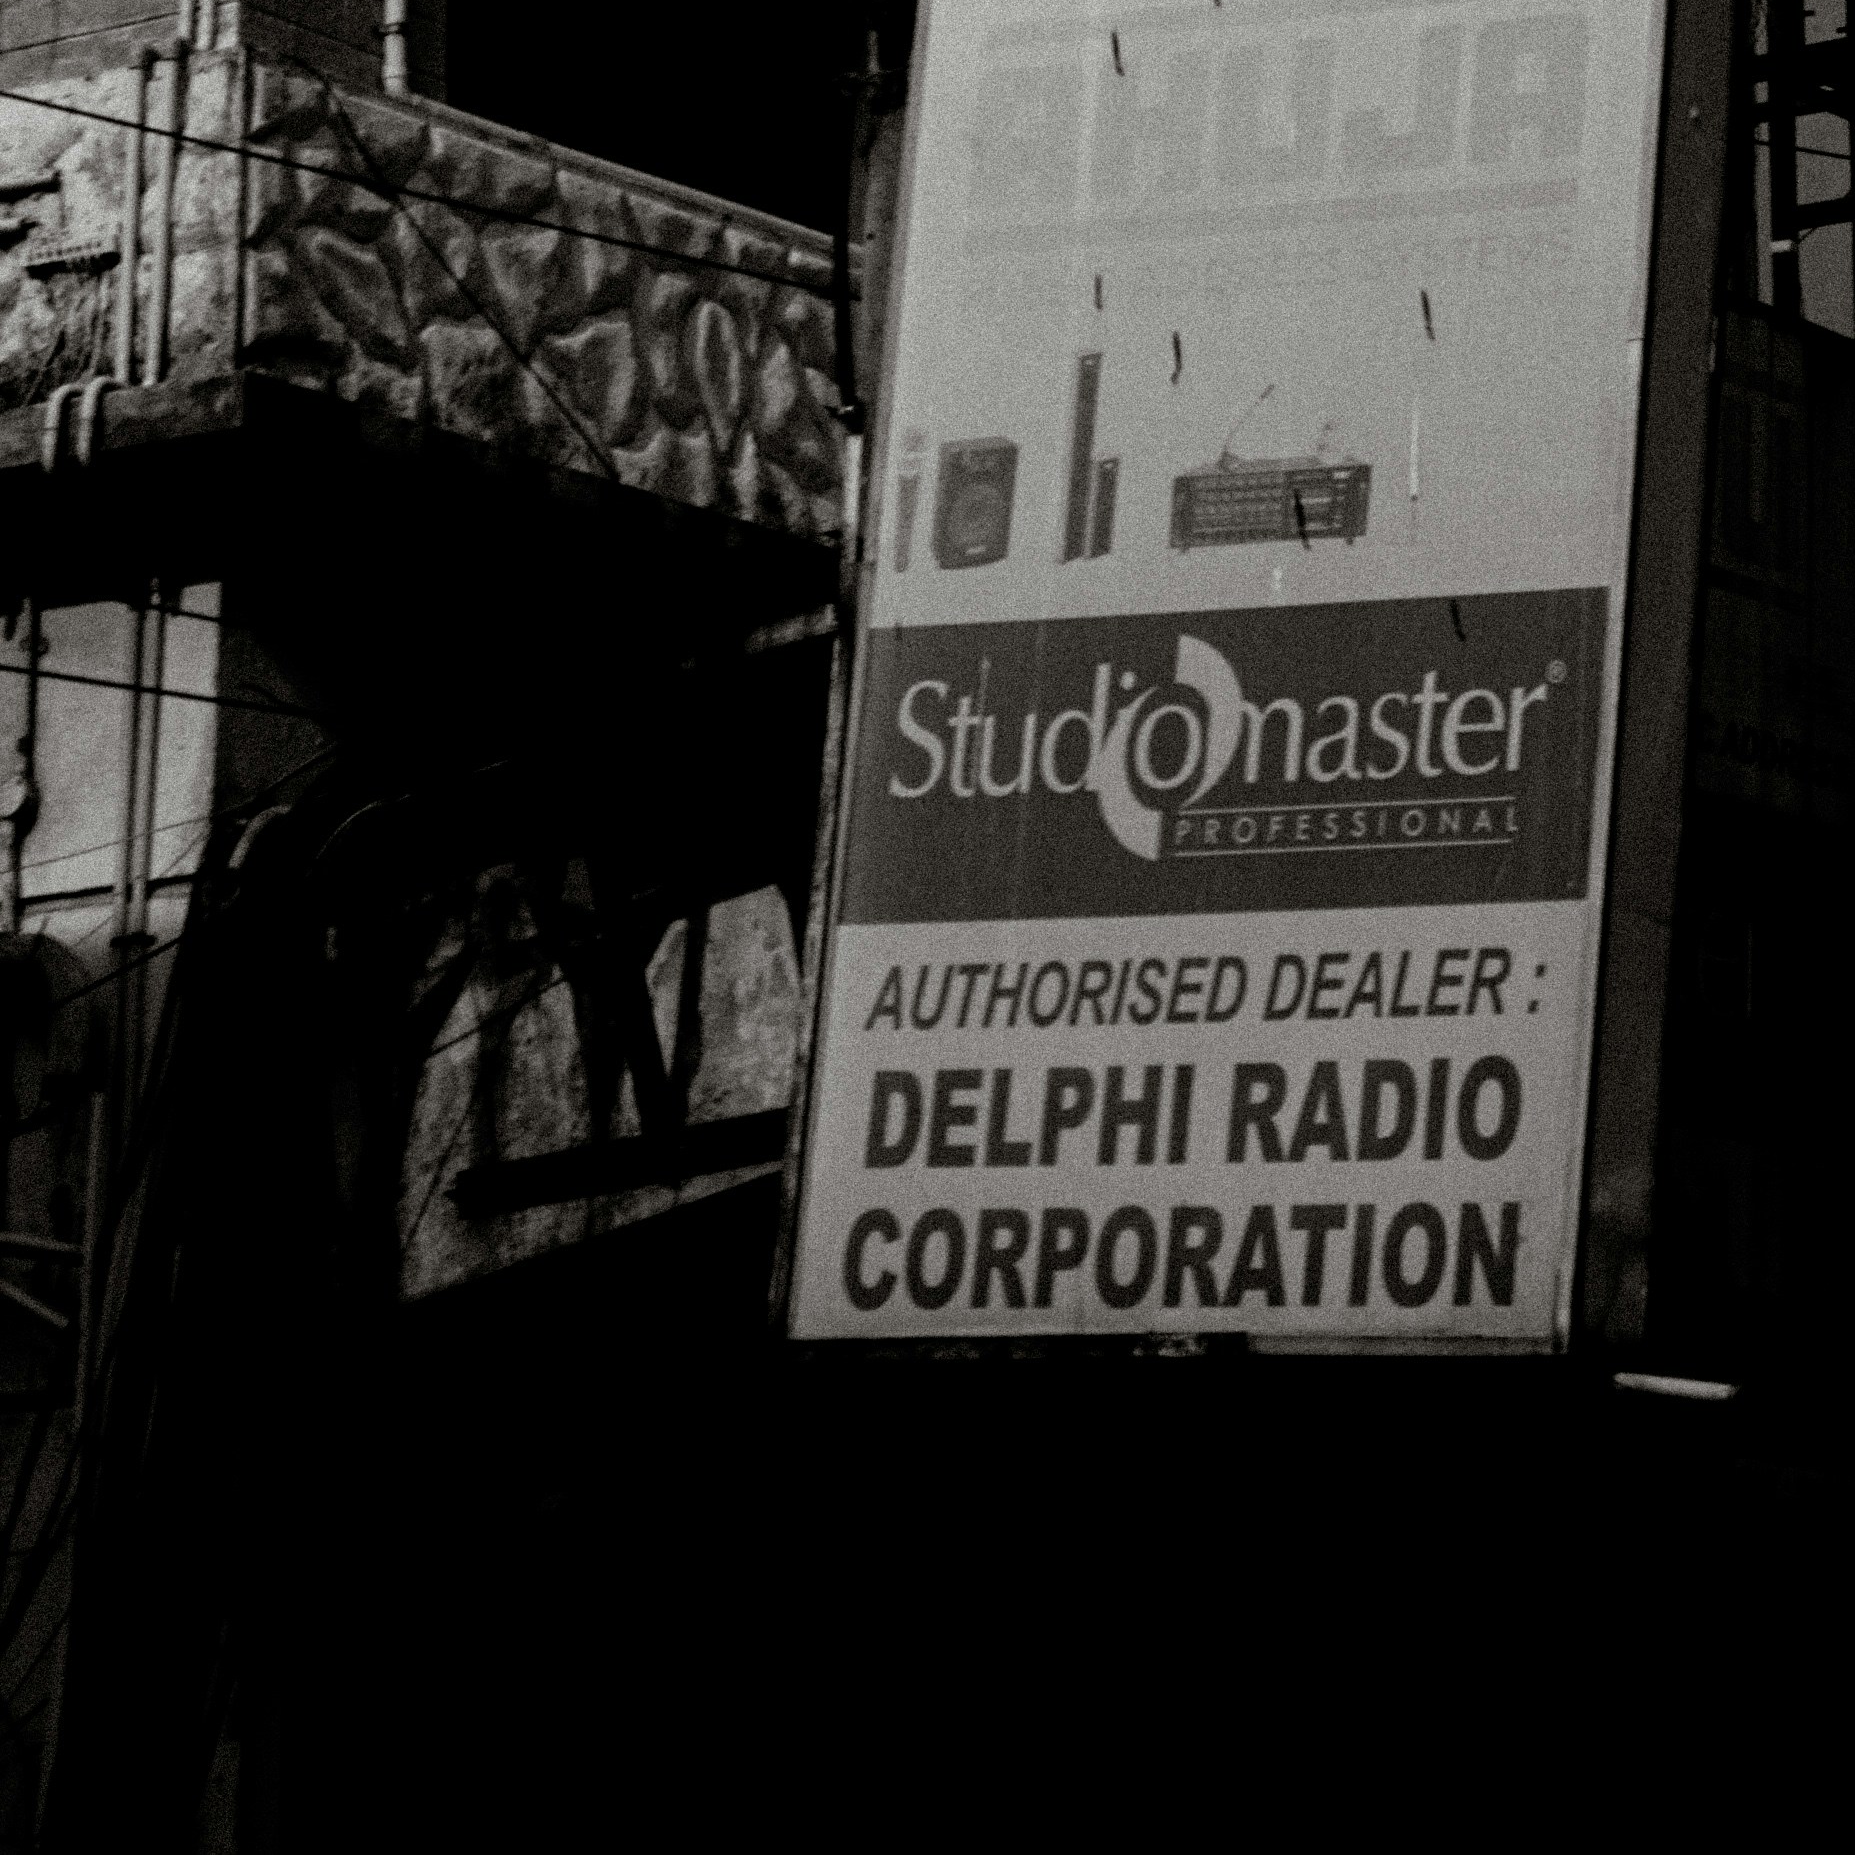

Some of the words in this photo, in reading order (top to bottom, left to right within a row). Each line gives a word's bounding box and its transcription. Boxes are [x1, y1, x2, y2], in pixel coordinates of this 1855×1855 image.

[888, 637, 1549, 856] Studiomaster
[1172, 801, 1522, 849] PROFESSIONAL
[864, 957, 1248, 1033] AUTHORISED
[1263, 947, 1514, 1024] DEALER
[864, 1062, 1197, 1170] DELPHI
[1225, 1054, 1525, 1163] RADIO
[842, 1199, 1523, 1313] CORPORATION
